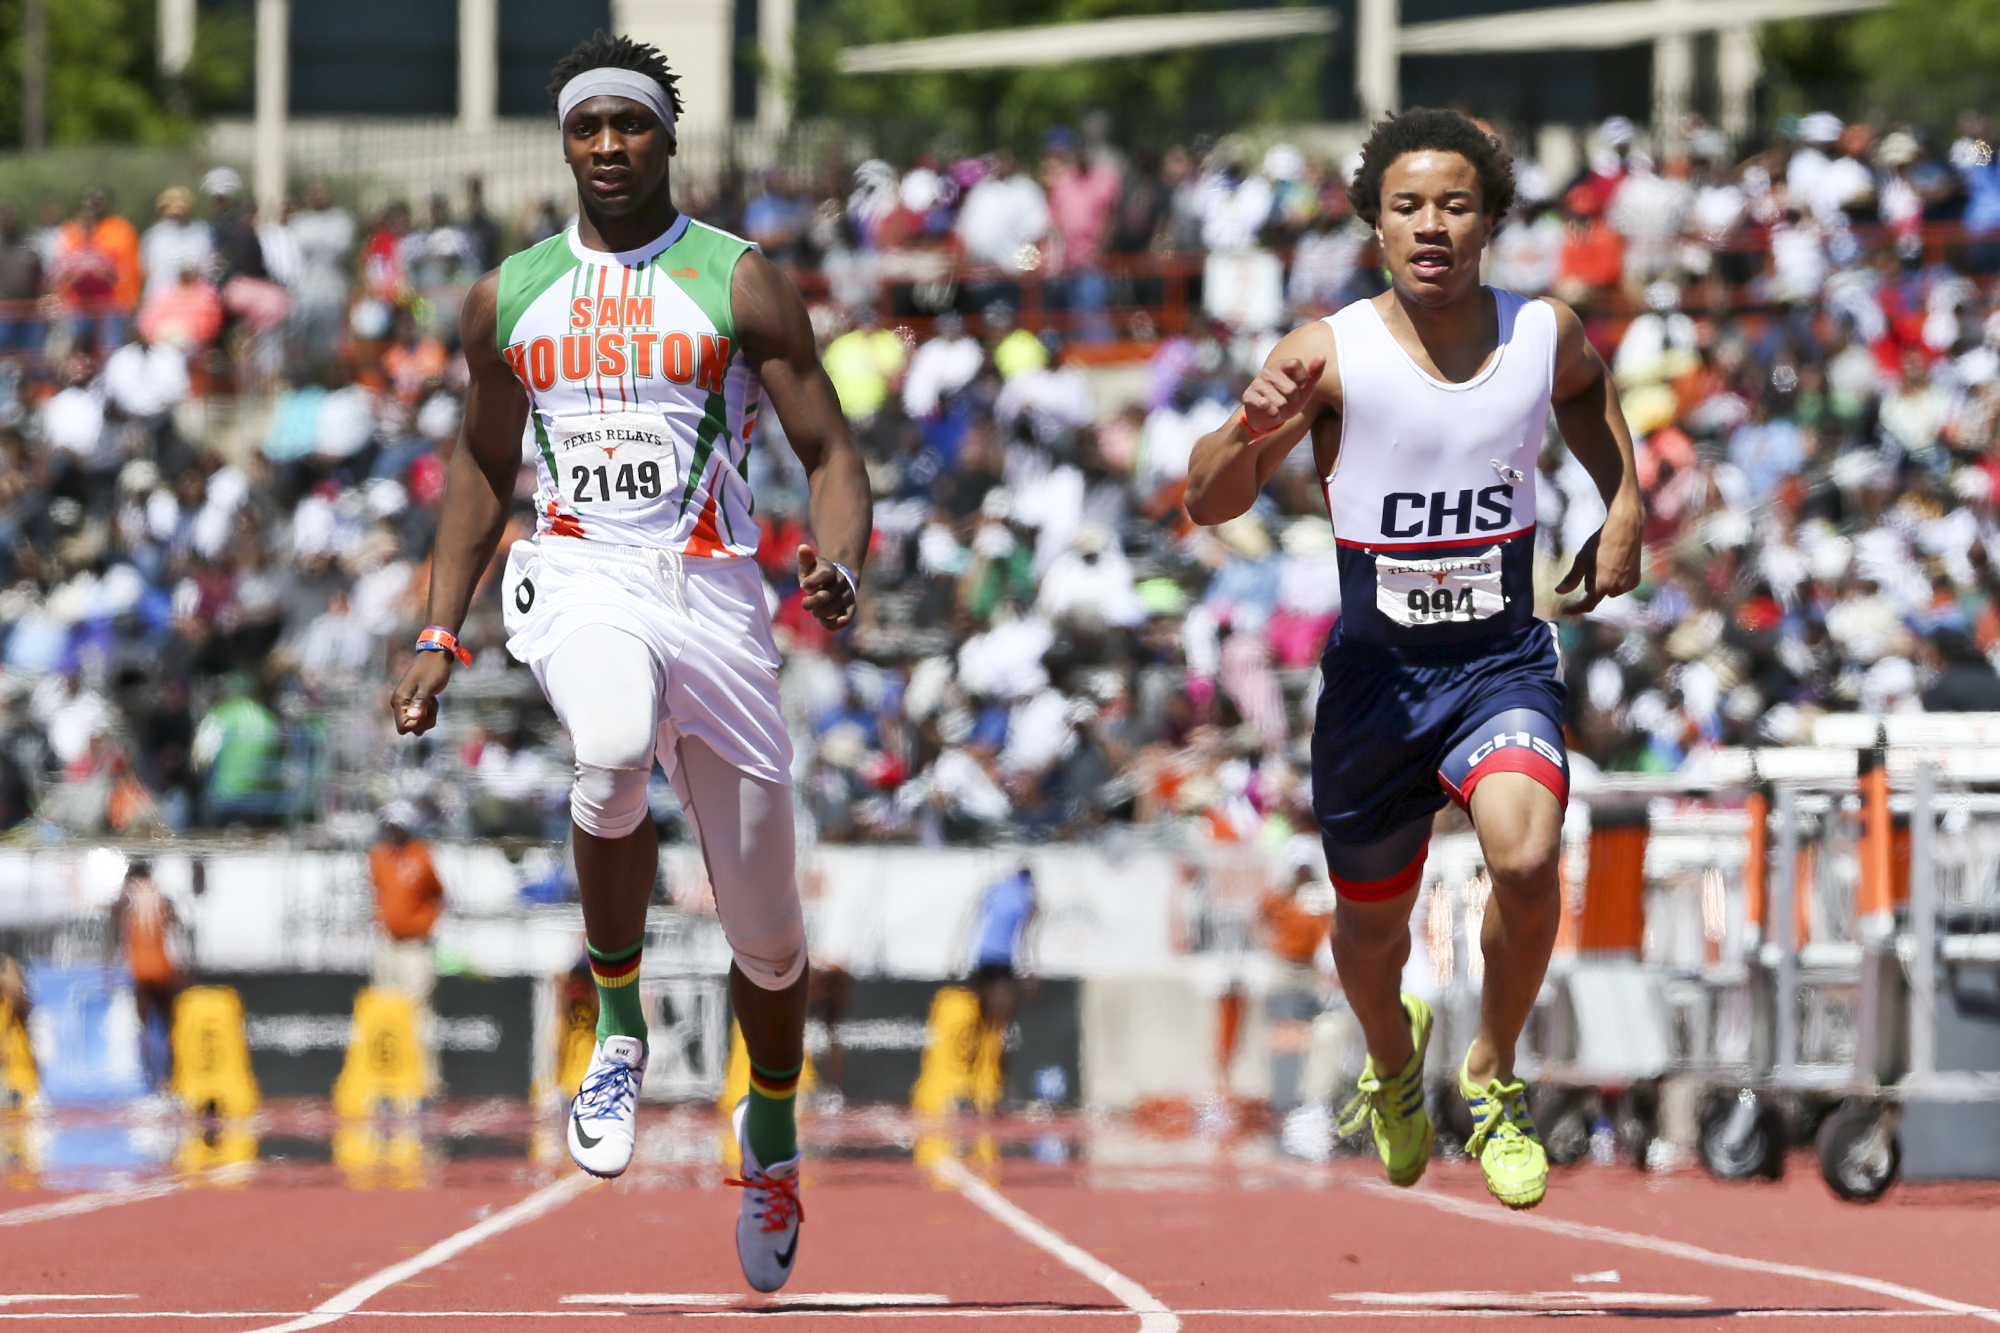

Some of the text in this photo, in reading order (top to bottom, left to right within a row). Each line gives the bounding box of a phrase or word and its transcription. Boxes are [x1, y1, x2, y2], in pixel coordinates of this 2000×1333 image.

[571, 296, 655, 329] SAM
[502, 331, 730, 397] HOUSTON
[563, 430, 602, 451] TEXAS
[606, 429, 662, 446] RELAYS
[572, 460, 662, 502] 2149
[1380, 484, 1513, 538] CHS
[1388, 563, 1434, 575] TEXAS
[1407, 587, 1476, 623] 994
[1467, 731, 1563, 768] CHS
